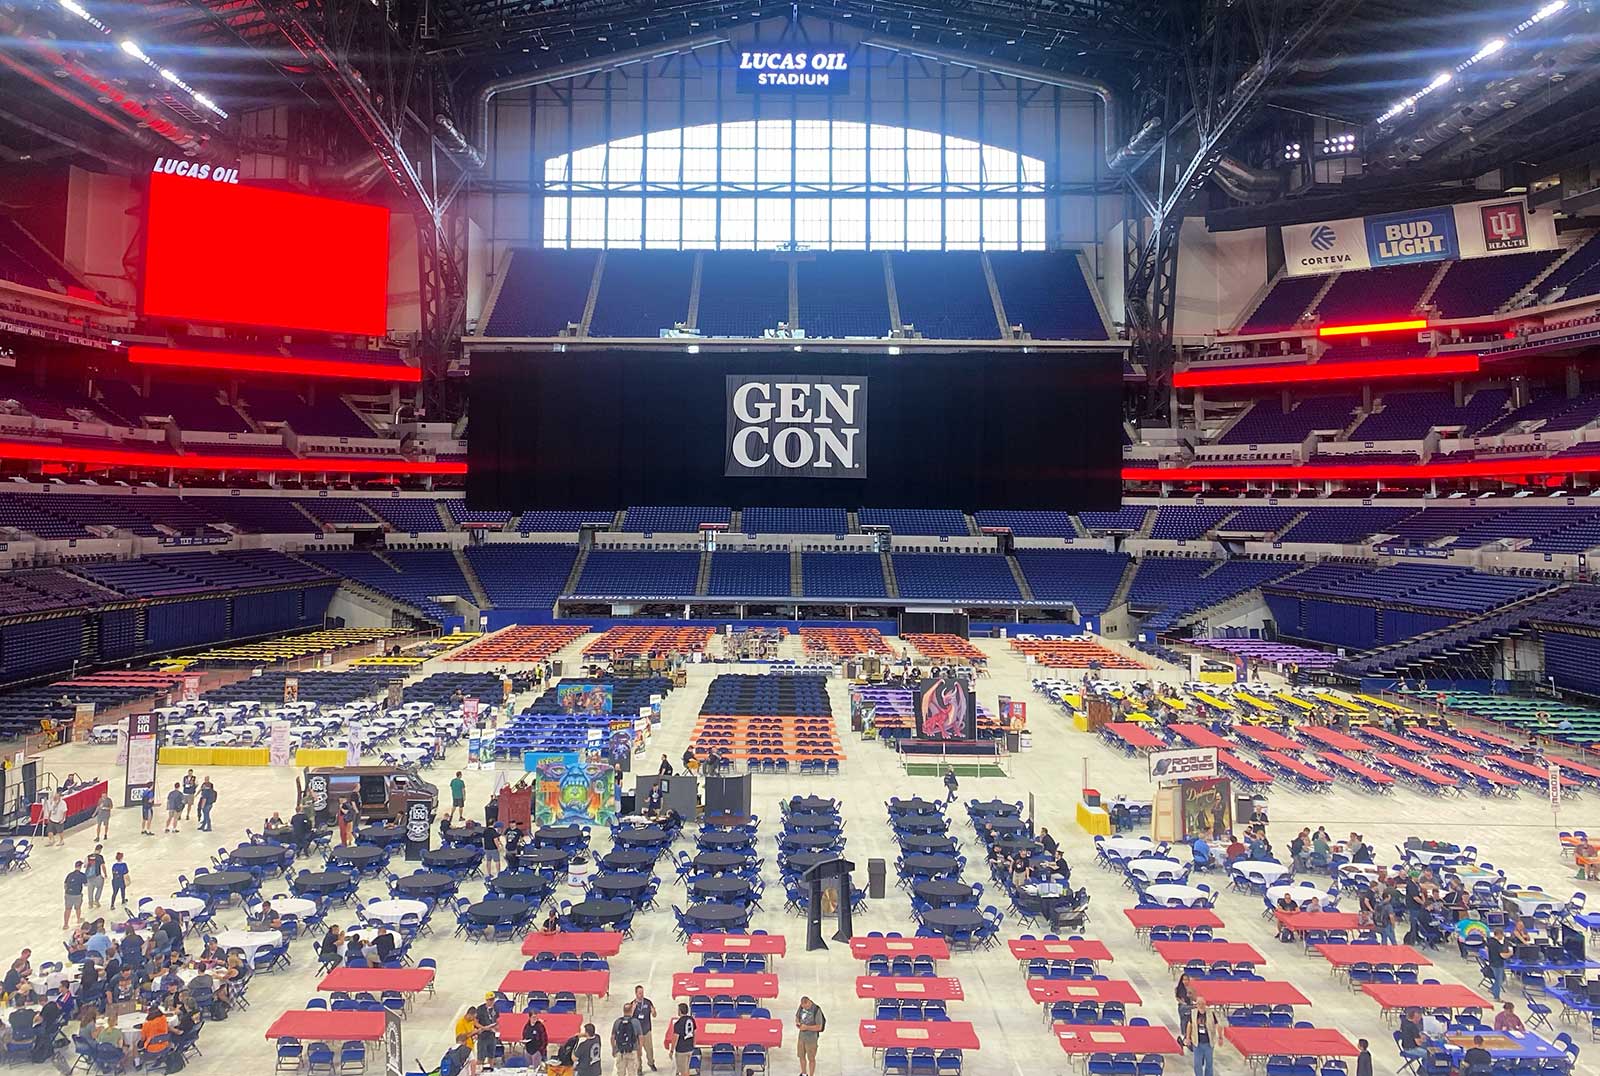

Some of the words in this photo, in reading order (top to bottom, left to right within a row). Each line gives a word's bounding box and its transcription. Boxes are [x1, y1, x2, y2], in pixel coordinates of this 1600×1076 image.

[740, 53, 806, 70] LUCAS
[811, 53, 848, 70] OIL
[758, 73, 829, 86] STADIUM
[153, 157, 211, 180] LUCAS
[212, 164, 240, 184] OIL
[1385, 220, 1434, 241] BUD
[1379, 236, 1445, 258] LIGHT
[1488, 239, 1527, 250] HEALTH
[1301, 254, 1352, 266] CORTEVA
[733, 382, 861, 424] GEN
[137, 724, 150, 733] HQ
[1172, 755, 1213, 766] ROGUE
[1168, 762, 1214, 774] JUDGES
